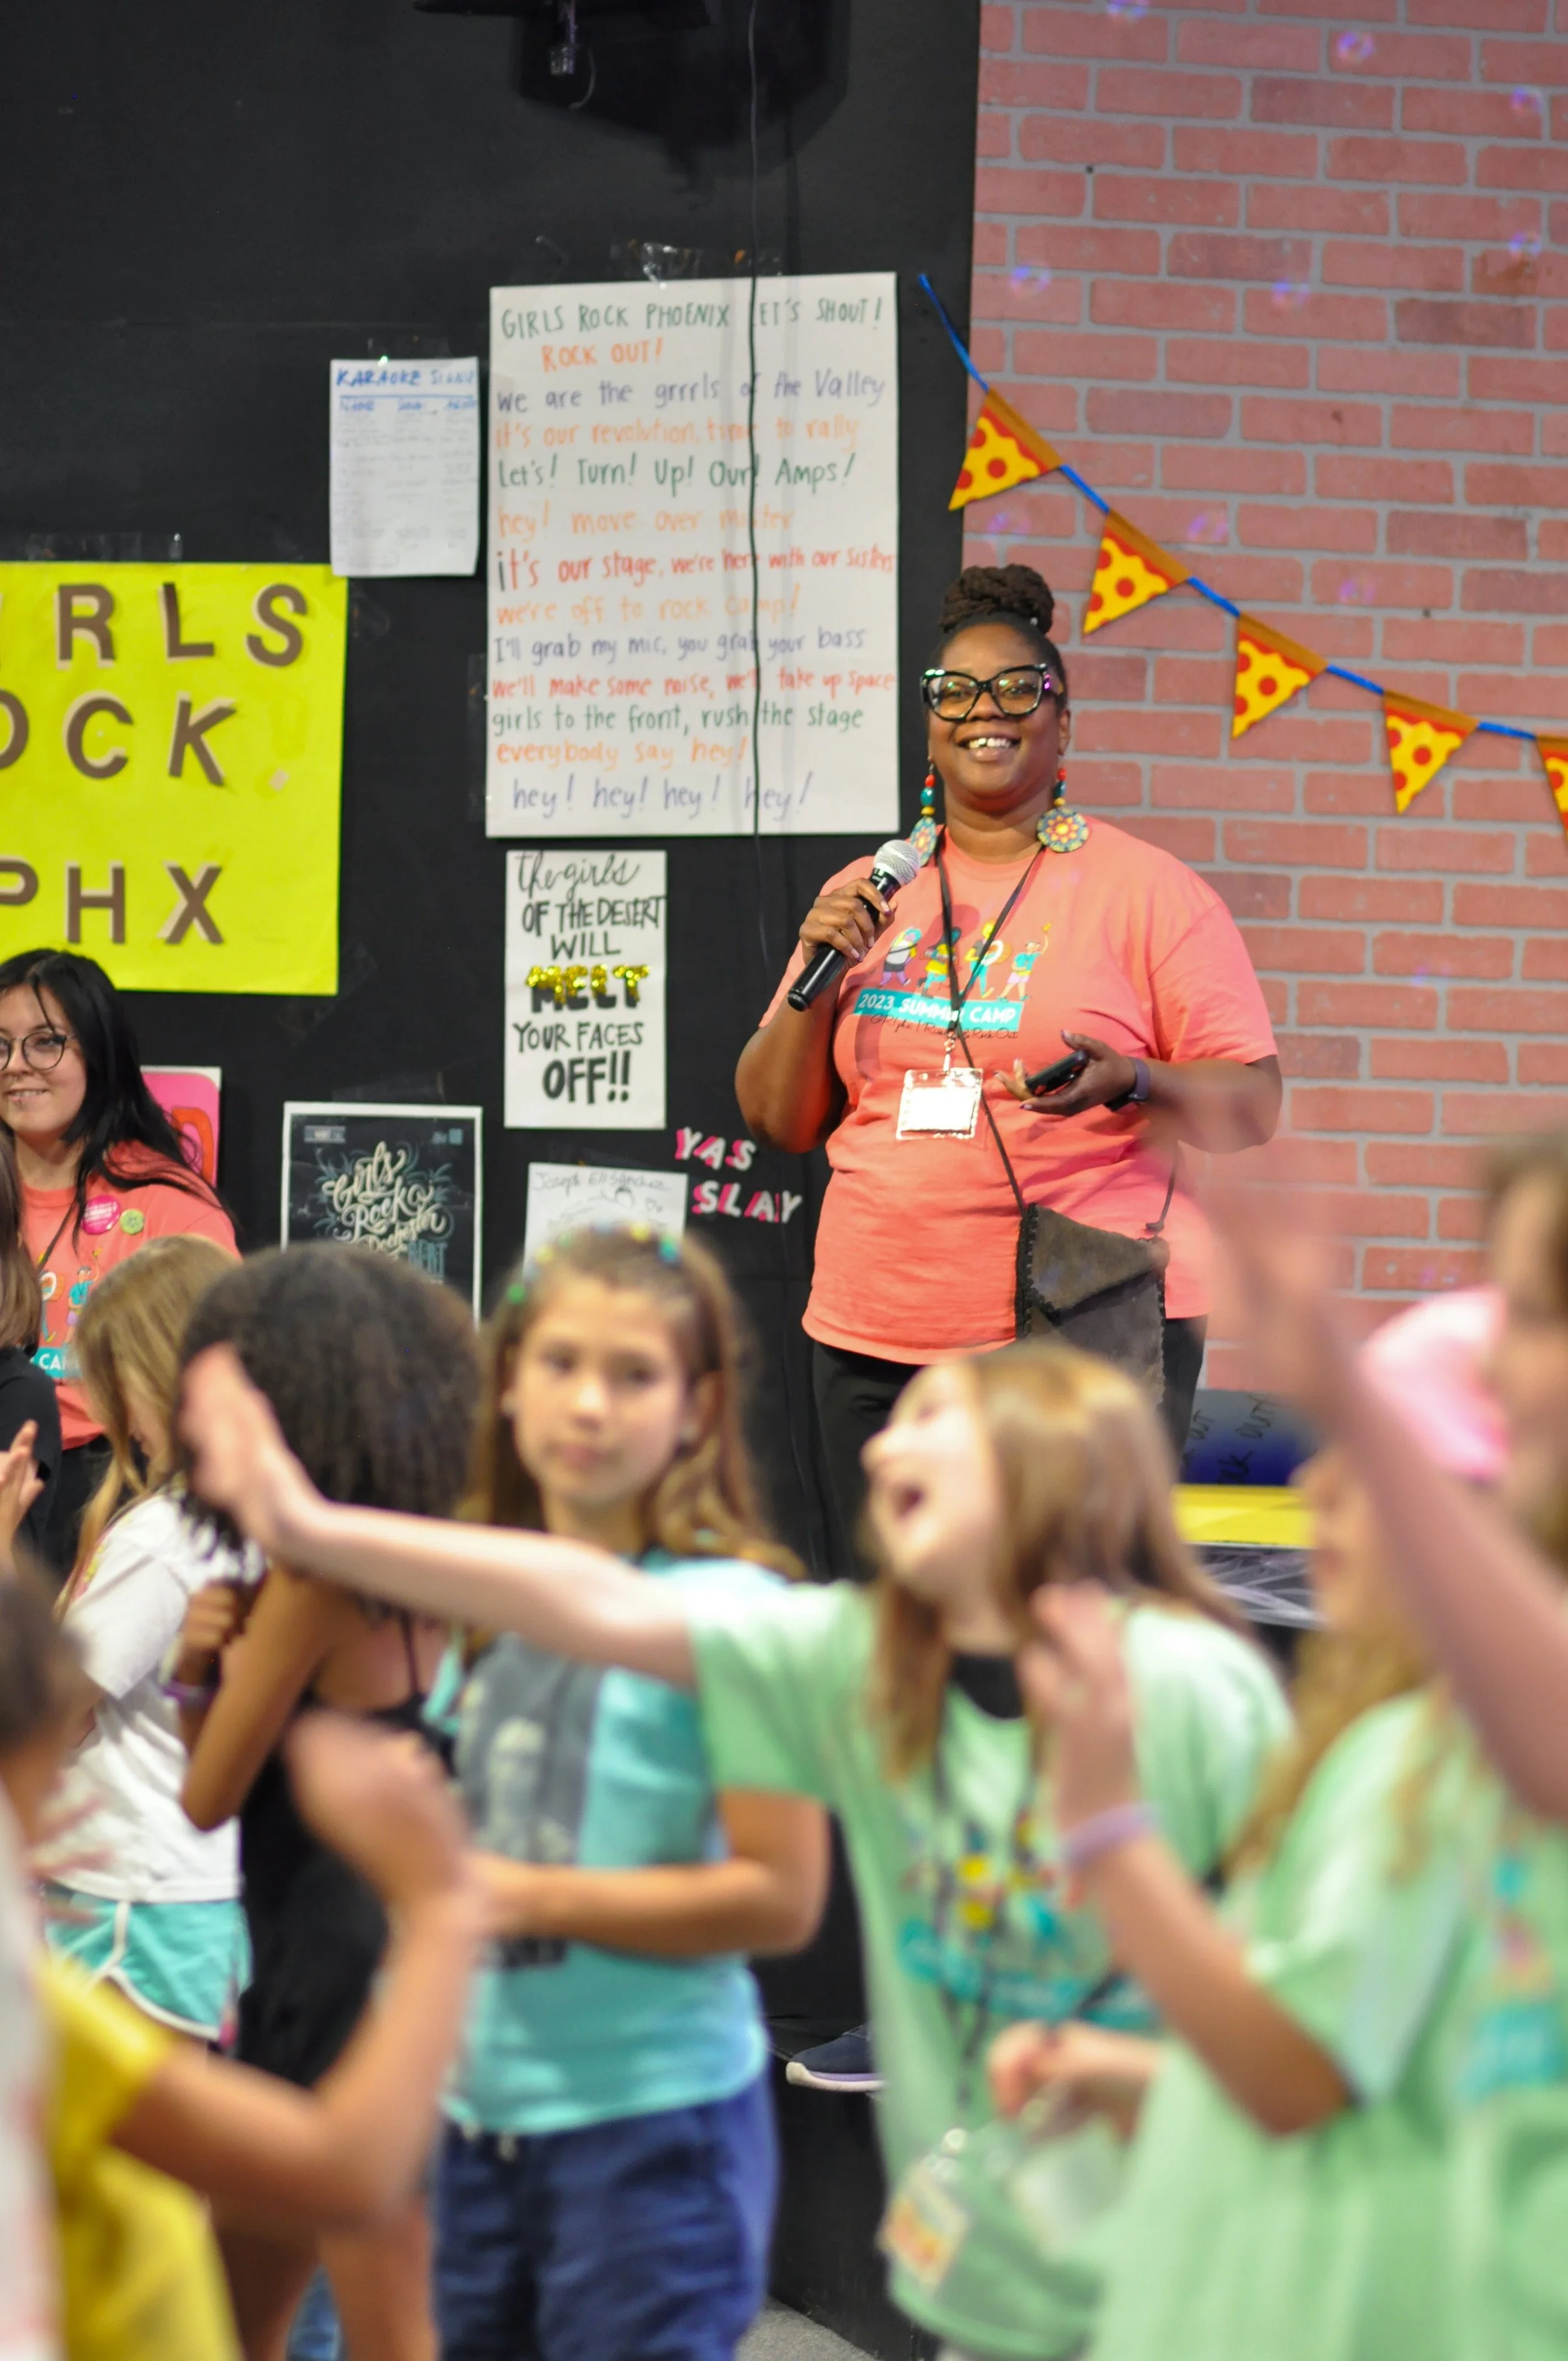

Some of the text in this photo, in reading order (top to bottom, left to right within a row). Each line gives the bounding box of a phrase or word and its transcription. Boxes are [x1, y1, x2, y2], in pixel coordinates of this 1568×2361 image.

[502, 297, 882, 339] GIRLS ROCK PHOENIX ET'S SHOUT!
[541, 336, 664, 373] ROCK OUT!
[336, 368, 421, 387] KARAOKE
[545, 390, 583, 409] are
[599, 379, 633, 406] the
[655, 371, 721, 410] grrrls
[774, 371, 802, 399] the
[815, 368, 886, 408] Valley
[544, 423, 580, 447] our
[775, 416, 794, 440] to
[806, 413, 859, 453] rally
[571, 509, 636, 538] move
[654, 509, 703, 534] over
[719, 504, 795, 531] miter
[558, 556, 591, 583] our
[769, 546, 805, 570] with
[812, 549, 840, 568] our
[55, 581, 309, 669] RLS
[571, 595, 604, 625] off
[622, 594, 644, 622] to
[659, 595, 710, 622] rock
[532, 632, 581, 666] grab
[591, 637, 618, 664] my
[677, 636, 708, 661] you
[766, 635, 806, 662] your
[818, 626, 867, 649] bass
[549, 674, 601, 698] make
[777, 666, 815, 691] take
[822, 674, 842, 700] up
[492, 703, 543, 737] girls
[554, 702, 575, 731] to
[583, 703, 617, 731] the
[701, 701, 749, 729] rush
[760, 699, 794, 726] the
[807, 701, 864, 733] stage
[495, 737, 620, 773] everybody
[634, 740, 675, 771] say
[522, 894, 667, 937] OF THE DESERT
[550, 930, 622, 961] WILL
[524, 962, 650, 1014] MELT
[857, 992, 896, 1011] 2023
[969, 1006, 1017, 1024] CAMP
[512, 1020, 645, 1054] YOUR FACES
[542, 1049, 632, 1105] OFF!!
[675, 1127, 756, 1171] YAS
[692, 1180, 802, 1224] SLAY
[39, 1353, 70, 1371] CA
